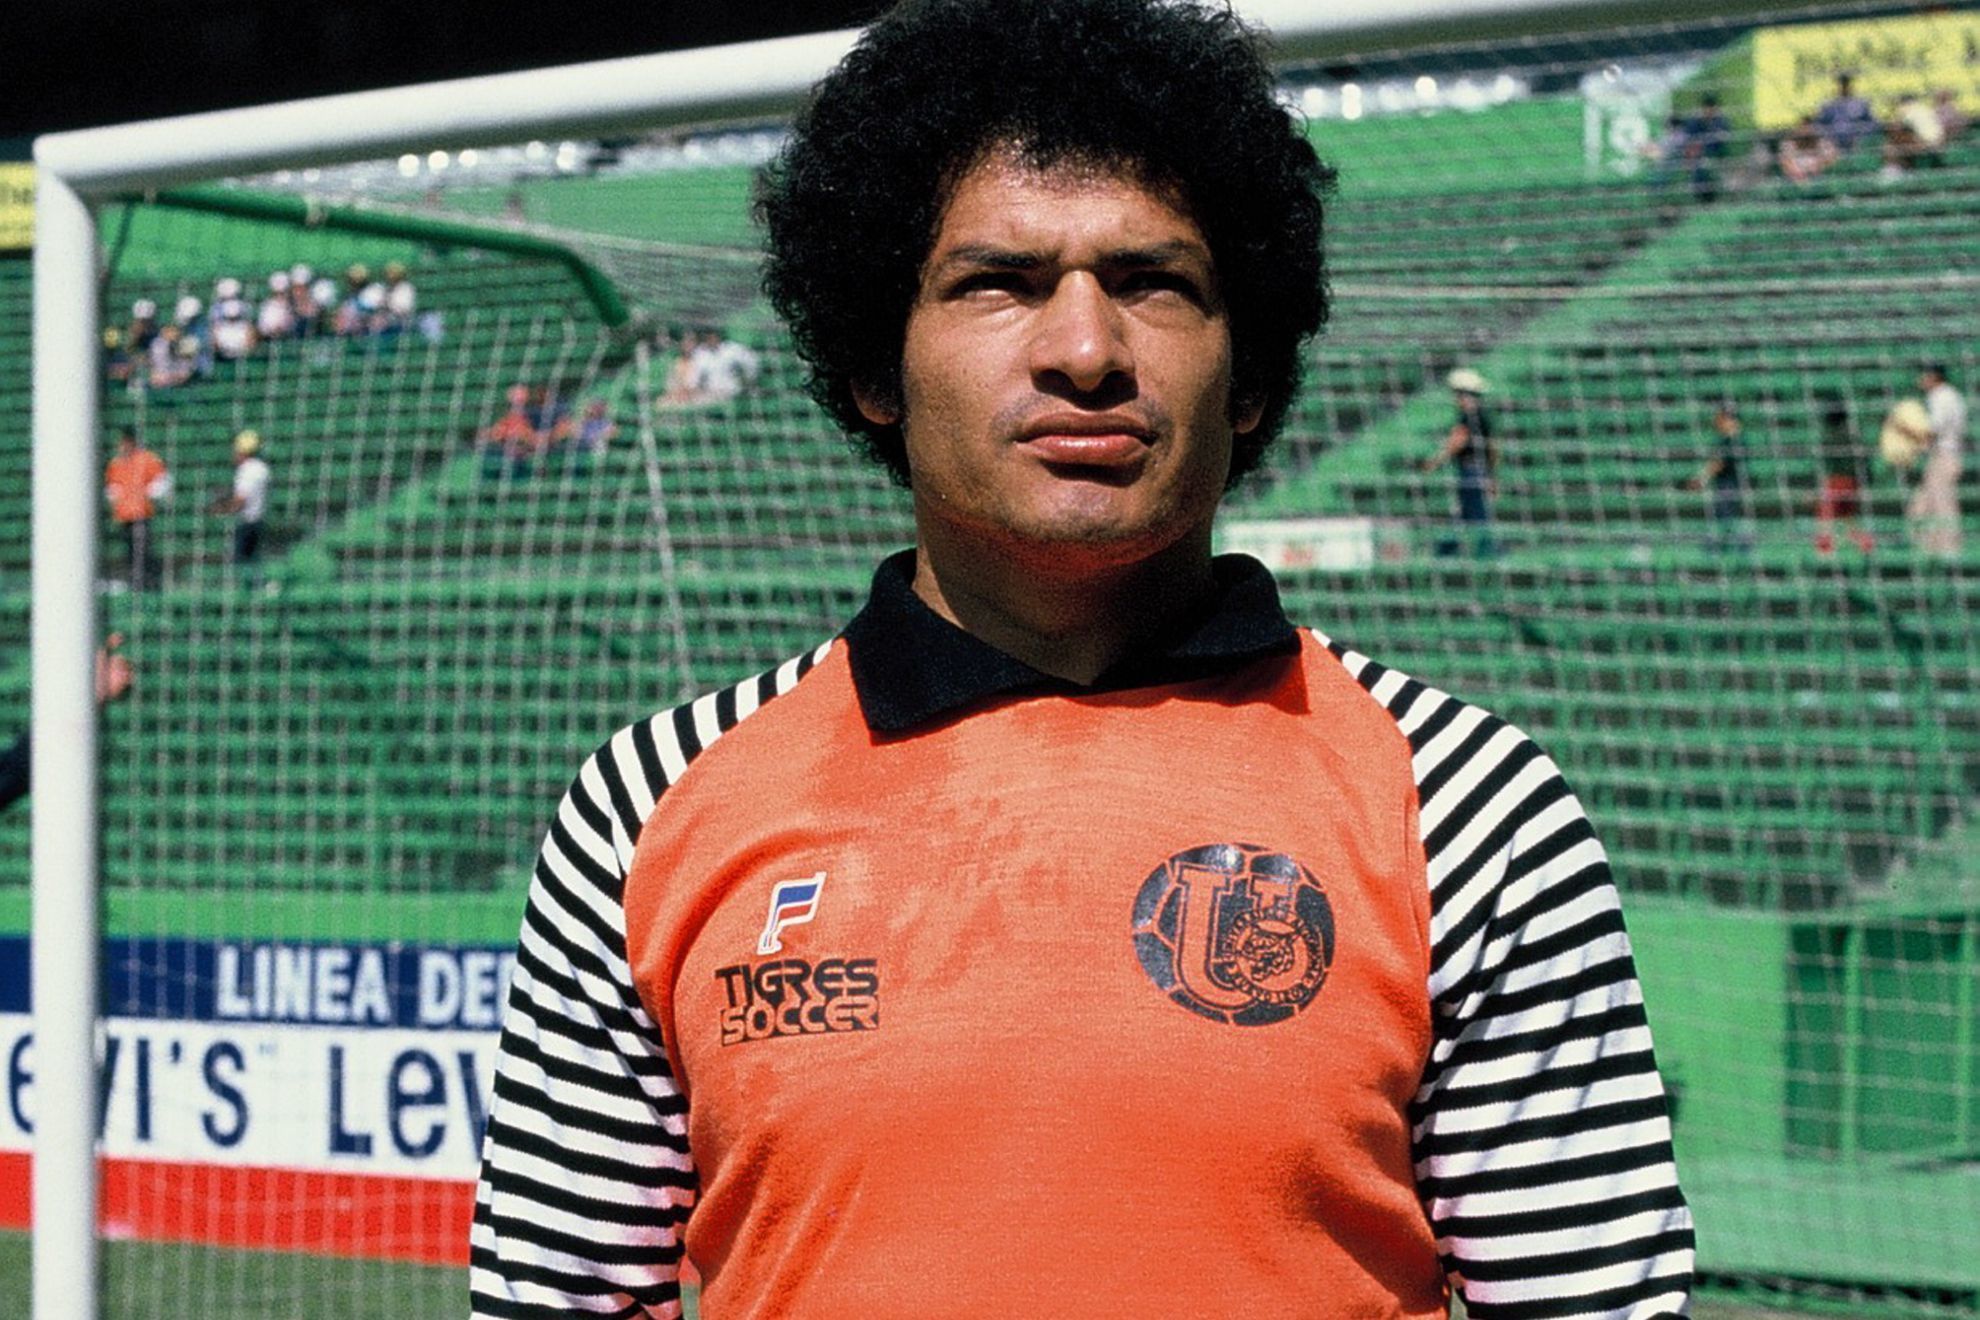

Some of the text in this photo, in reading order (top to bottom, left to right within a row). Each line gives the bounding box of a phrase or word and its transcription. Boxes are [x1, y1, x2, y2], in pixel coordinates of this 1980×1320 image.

[217, 946, 390, 1022] LINEA
[715, 958, 878, 1007] TIGRES
[720, 994, 879, 1046] SOCCER
